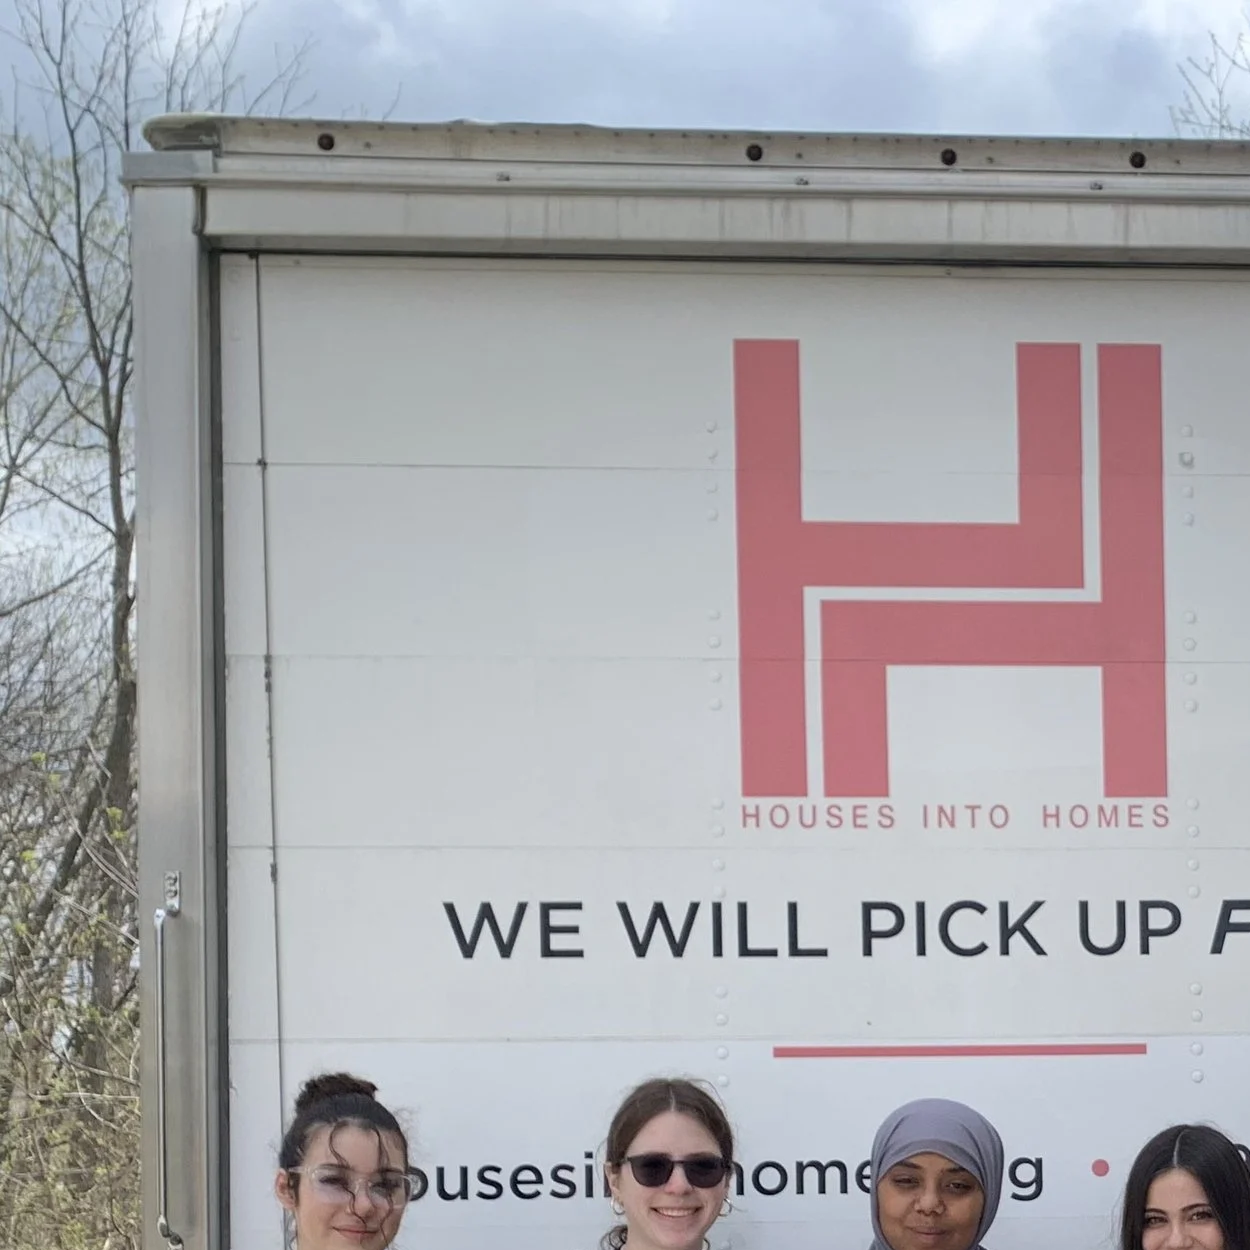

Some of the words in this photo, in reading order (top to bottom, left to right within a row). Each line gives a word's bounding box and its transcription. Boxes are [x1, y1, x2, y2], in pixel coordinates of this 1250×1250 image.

[741, 803, 896, 830] HOUSES
[922, 803, 1011, 830] INTO
[1042, 803, 1171, 829] HOMES
[442, 900, 585, 959] WE
[615, 900, 828, 958] WILL
[861, 899, 1049, 957] PICK
[1078, 899, 1182, 956] UP
